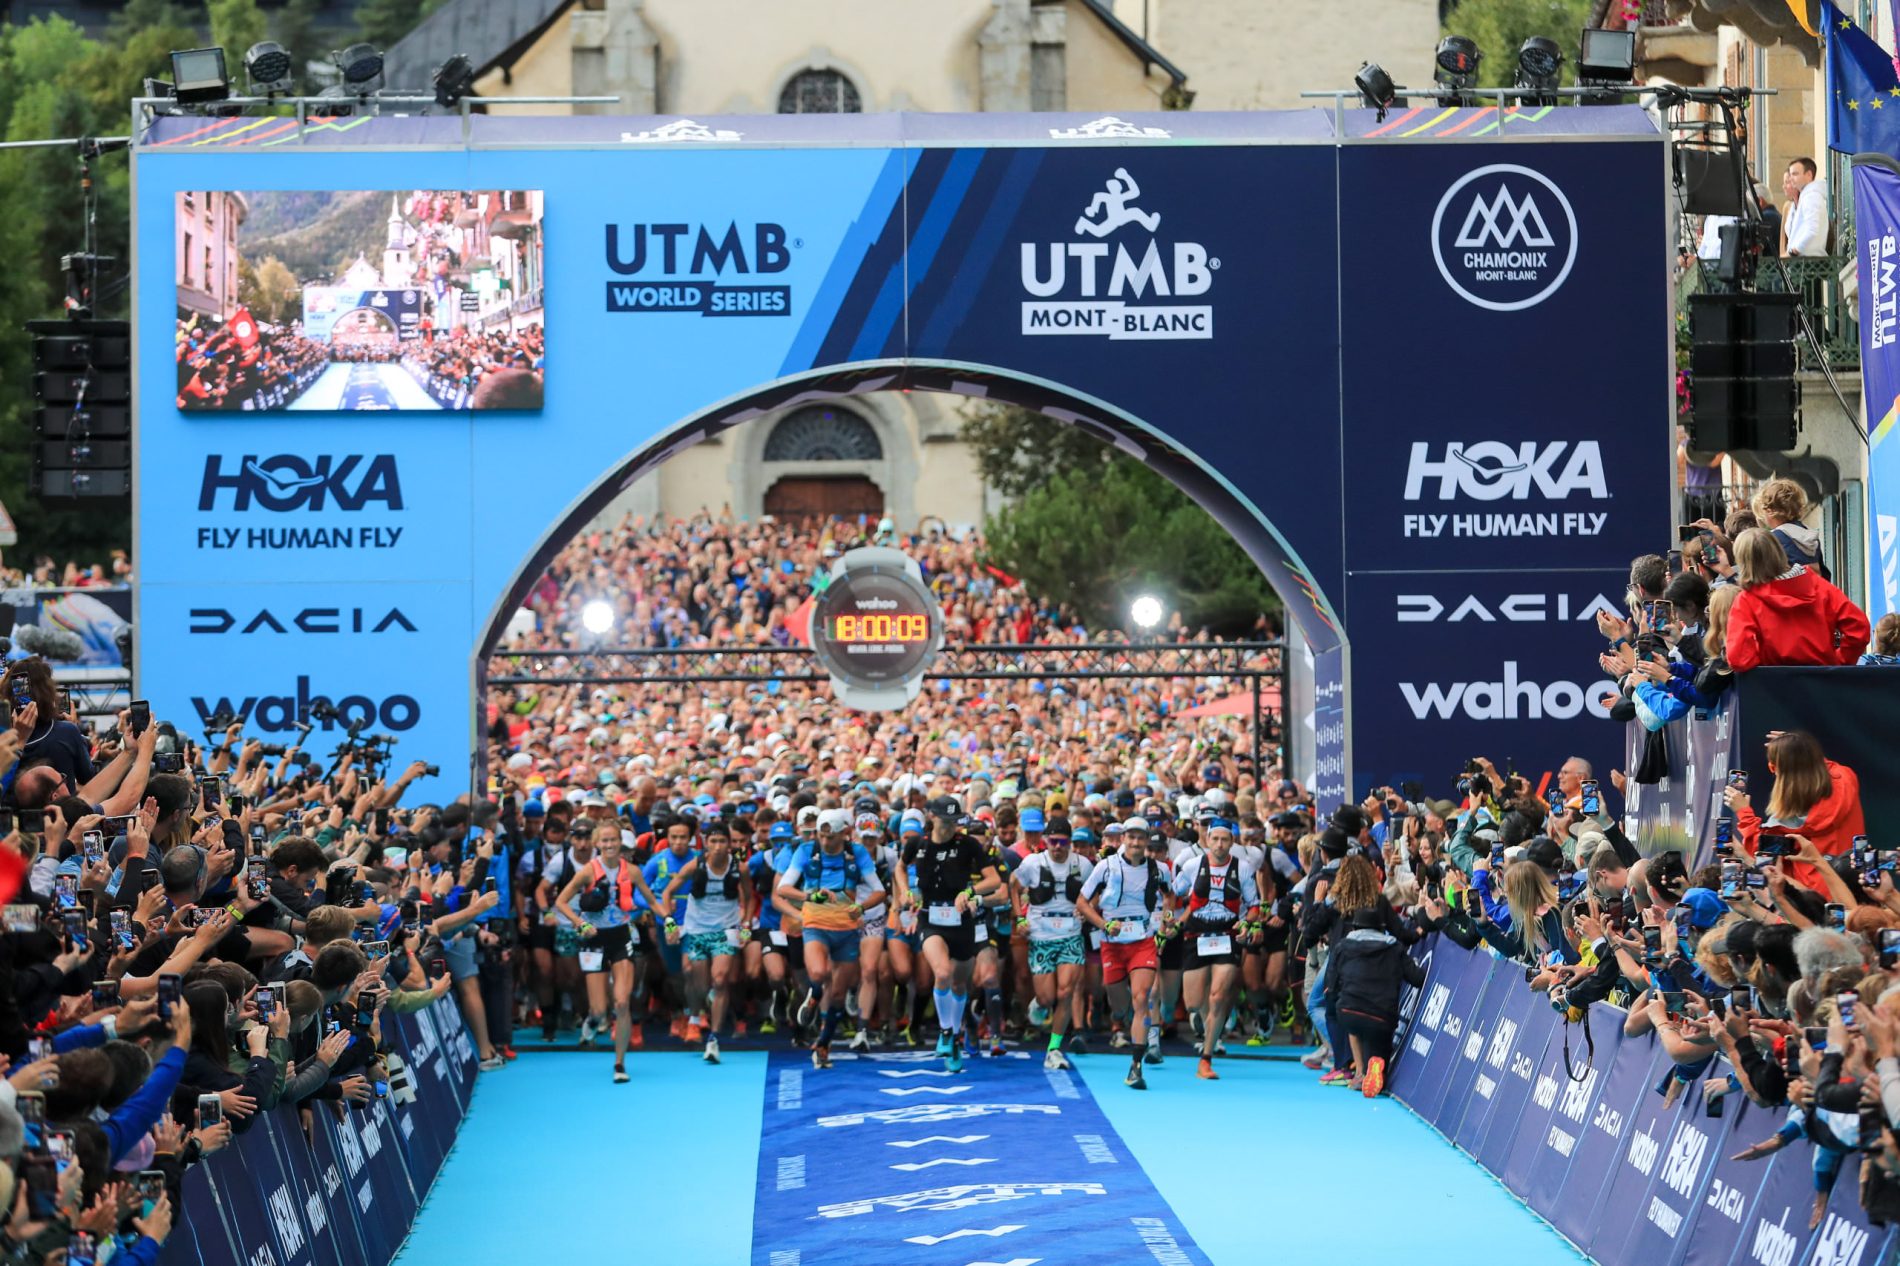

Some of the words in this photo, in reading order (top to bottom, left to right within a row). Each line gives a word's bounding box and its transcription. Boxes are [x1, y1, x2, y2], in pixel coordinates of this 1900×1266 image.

[1464, 251, 1547, 268] CHAMONIX
[613, 287, 702, 307] WORLD
[711, 291, 786, 311] SERIES
[197, 454, 405, 512] HOKA
[1404, 440, 1608, 501] HOKA
[198, 527, 241, 549] FLY
[248, 527, 353, 549] HUMAN
[360, 526, 404, 548] FLY
[1404, 513, 1448, 538] FLY
[1453, 512, 1558, 537] HUMAN
[1563, 512, 1608, 536] FLY
[855, 596, 898, 610] wahoo
[1397, 593, 1625, 622] DACIA
[190, 607, 419, 634] DACIA
[190, 675, 421, 732] wahoo
[1707, 1178, 1745, 1224] DACIA
